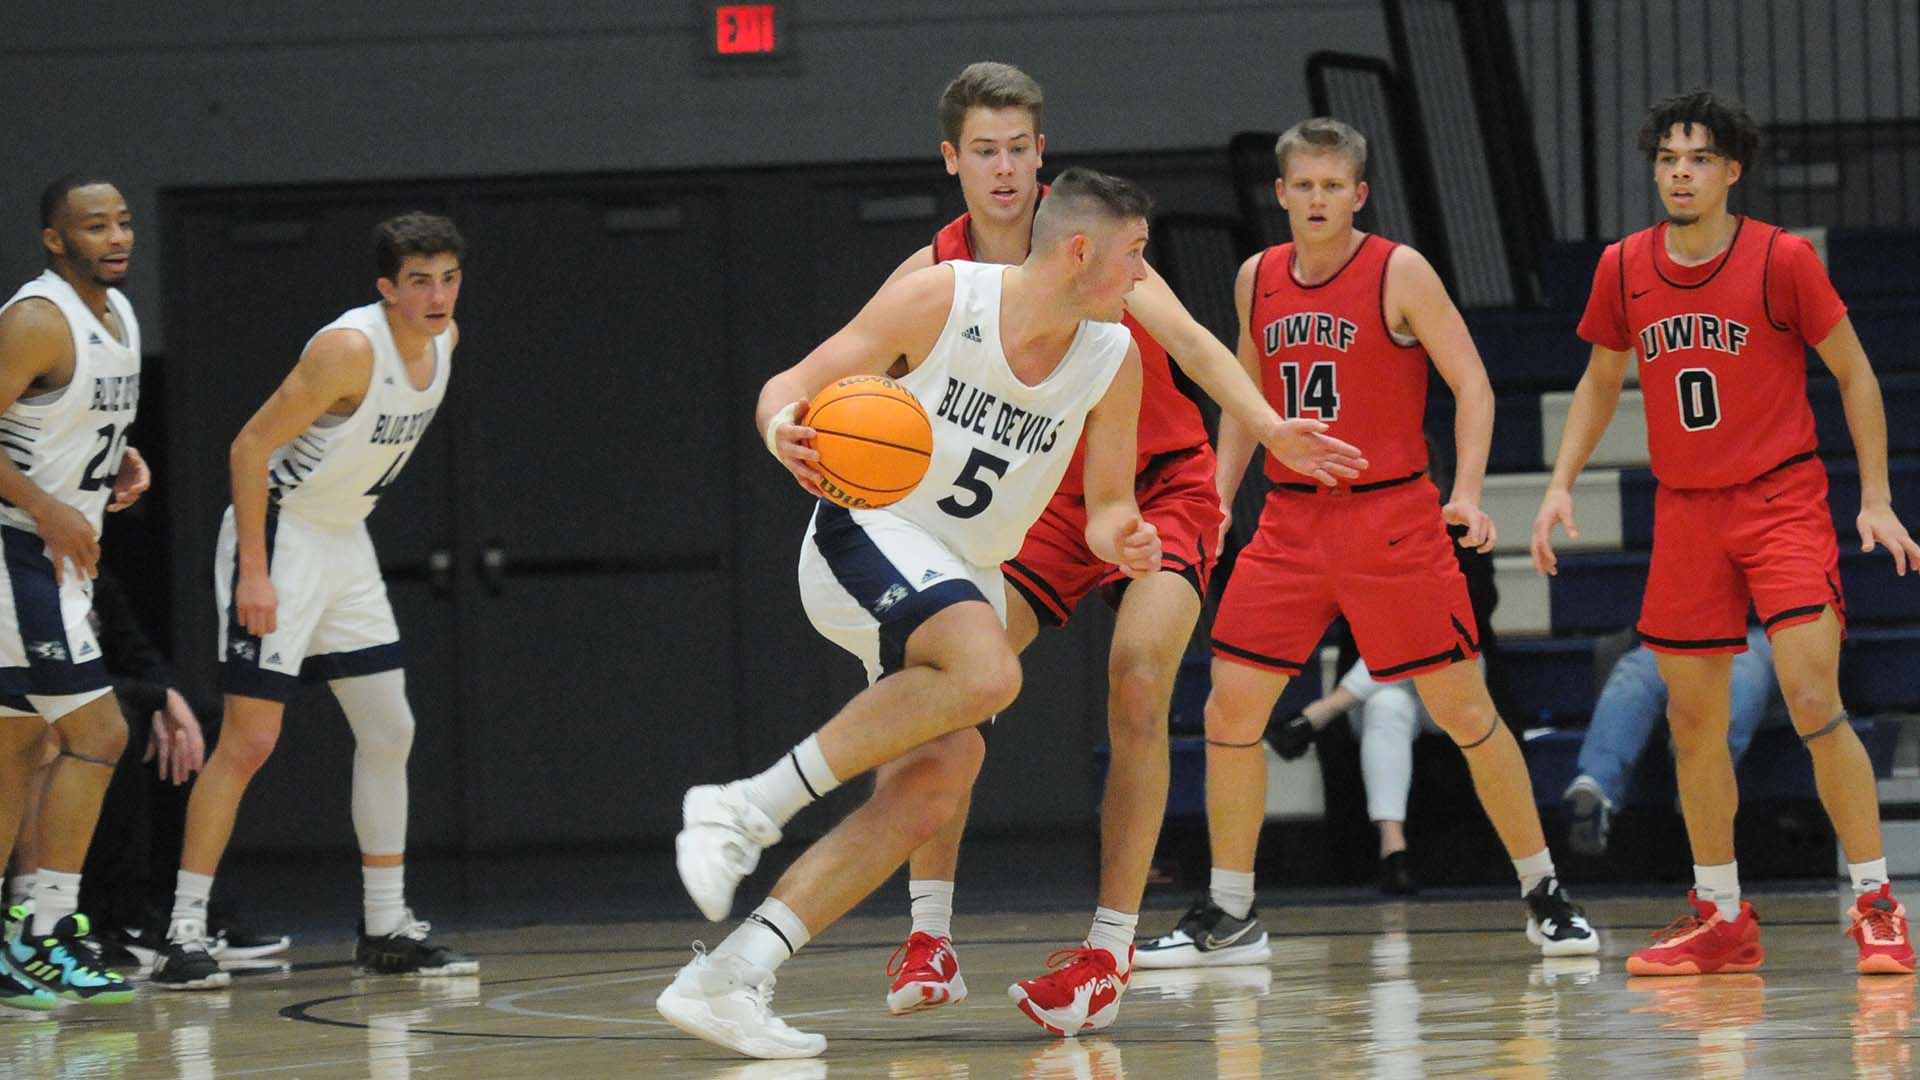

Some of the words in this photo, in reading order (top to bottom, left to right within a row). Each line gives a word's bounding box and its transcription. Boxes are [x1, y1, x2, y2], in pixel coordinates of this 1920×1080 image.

[716, 5, 775, 54] EXIT
[1264, 312, 1358, 357] UWRF
[1639, 313, 1750, 362] UWRF
[936, 377, 996, 435] BLUE
[1280, 361, 1340, 421] 14
[1675, 368, 1721, 432] 0
[370, 414, 409, 445] BLUE
[936, 447, 1010, 519] 5
